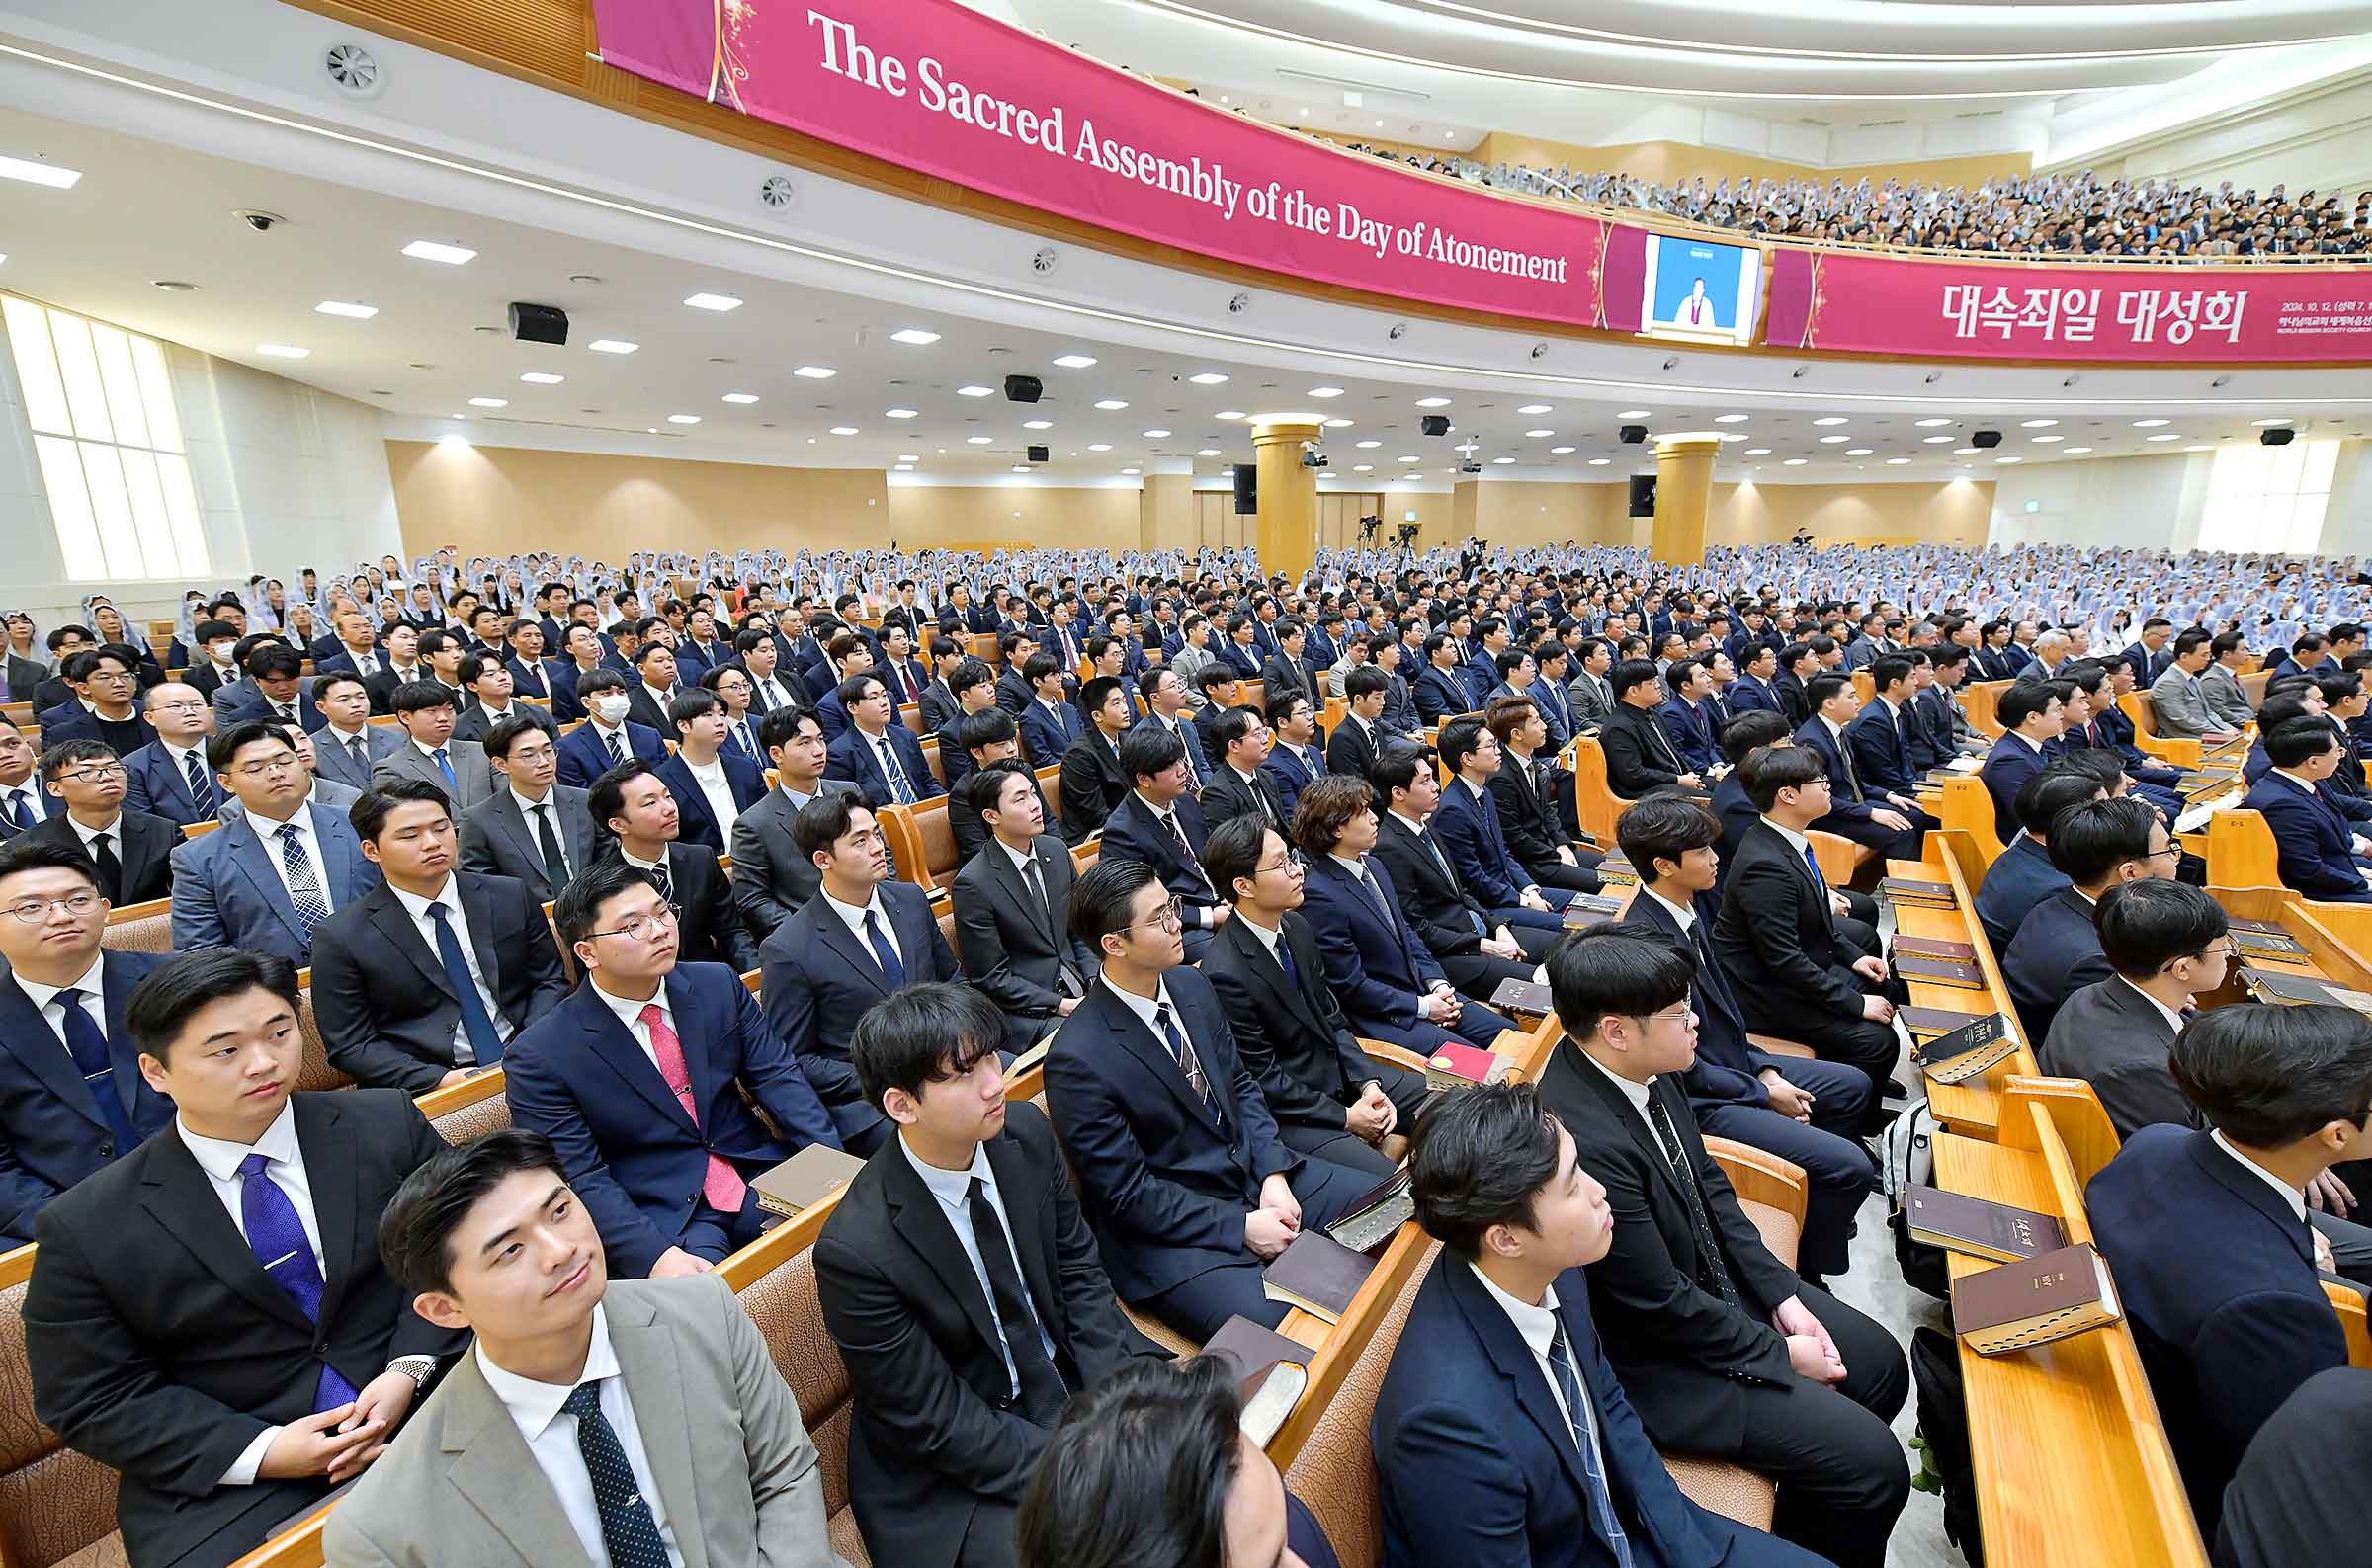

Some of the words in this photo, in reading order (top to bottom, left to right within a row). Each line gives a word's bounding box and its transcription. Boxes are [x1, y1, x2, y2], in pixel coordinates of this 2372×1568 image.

[807, 9, 907, 97] The
[917, 57, 1067, 156] Sacred
[1073, 119, 1242, 221] Assembly
[1247, 183, 1281, 221] of
[1283, 189, 1331, 235] the
[1336, 203, 1393, 259] Day
[1397, 223, 1426, 257] of
[1426, 227, 1567, 284] Atonement
[1942, 284, 2102, 342] 대속죄일
[2117, 290, 2248, 345] 대성회
[2307, 301, 2319, 312] 10.
